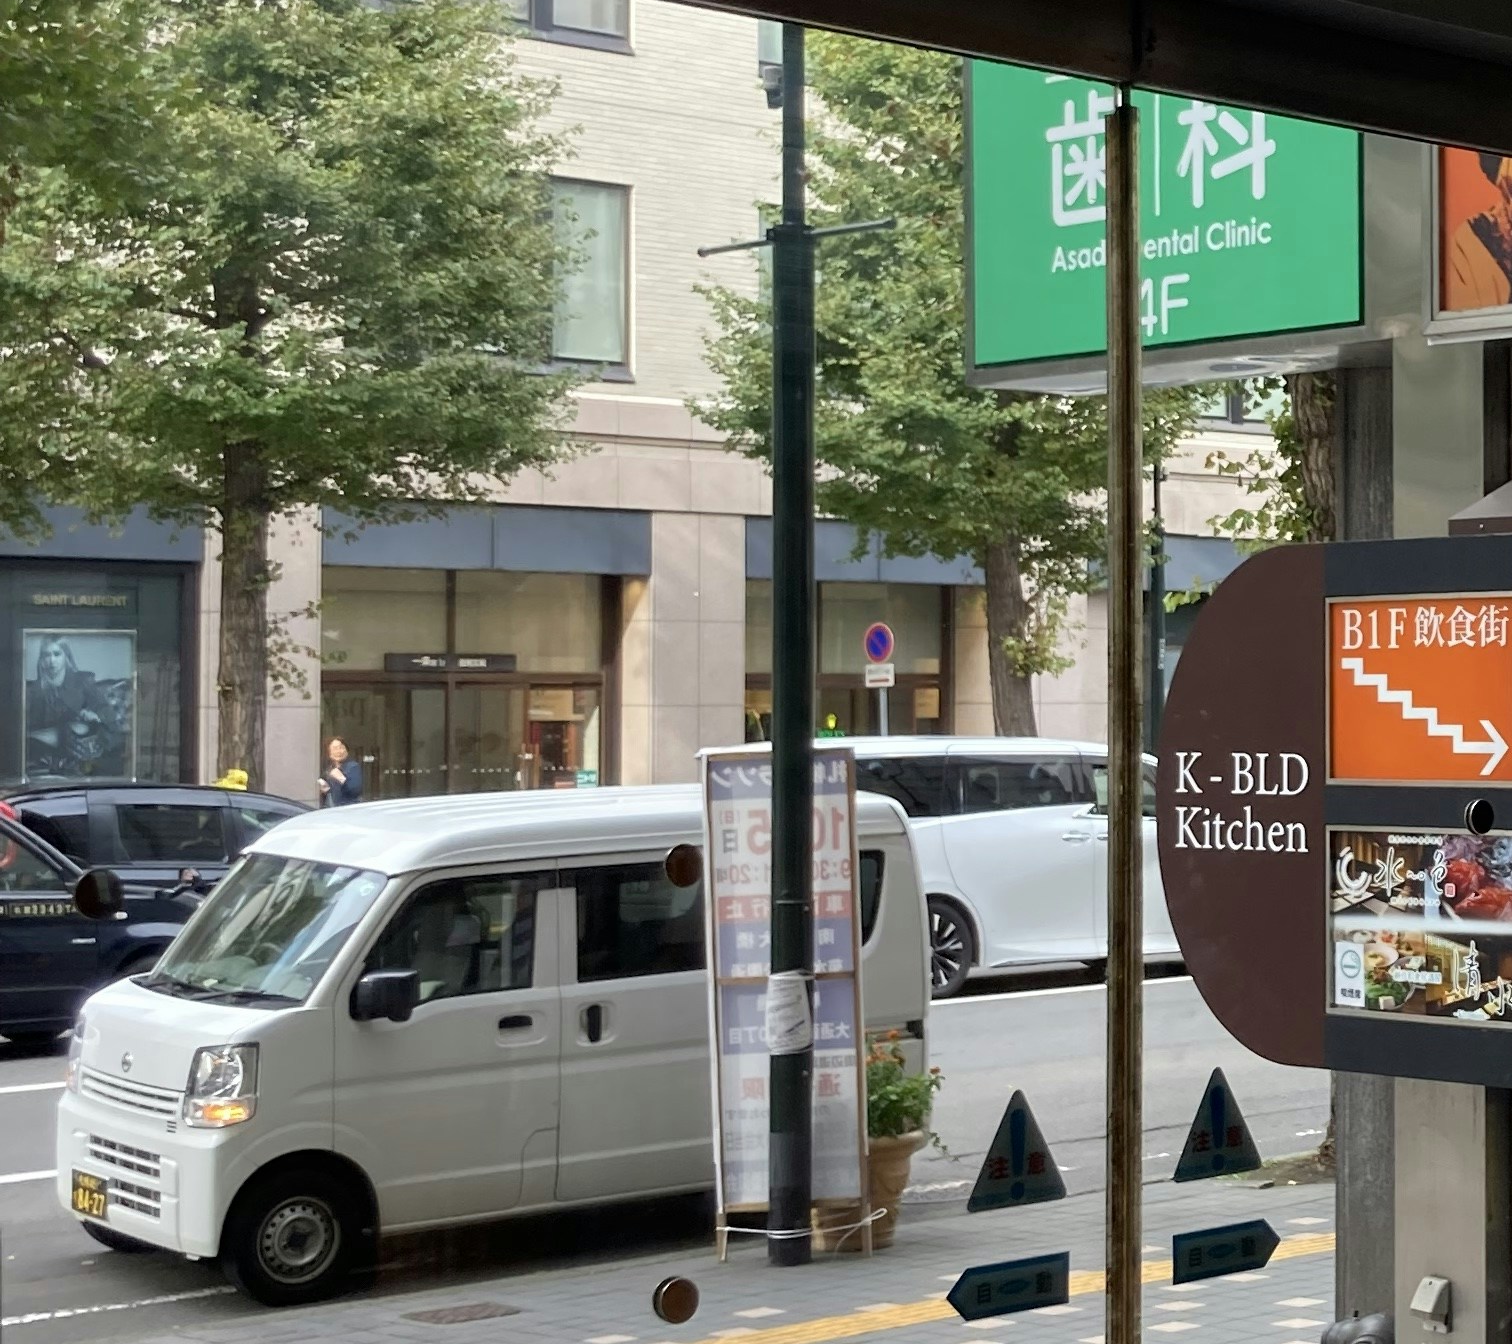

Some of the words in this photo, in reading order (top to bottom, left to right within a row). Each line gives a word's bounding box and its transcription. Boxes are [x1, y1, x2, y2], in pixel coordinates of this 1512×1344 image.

[1206, 216, 1272, 252] Clinic
[1341, 607, 1408, 650] B1F
[1414, 605, 1509, 649] 飲食街
[1175, 806, 1309, 853] Kitchen
